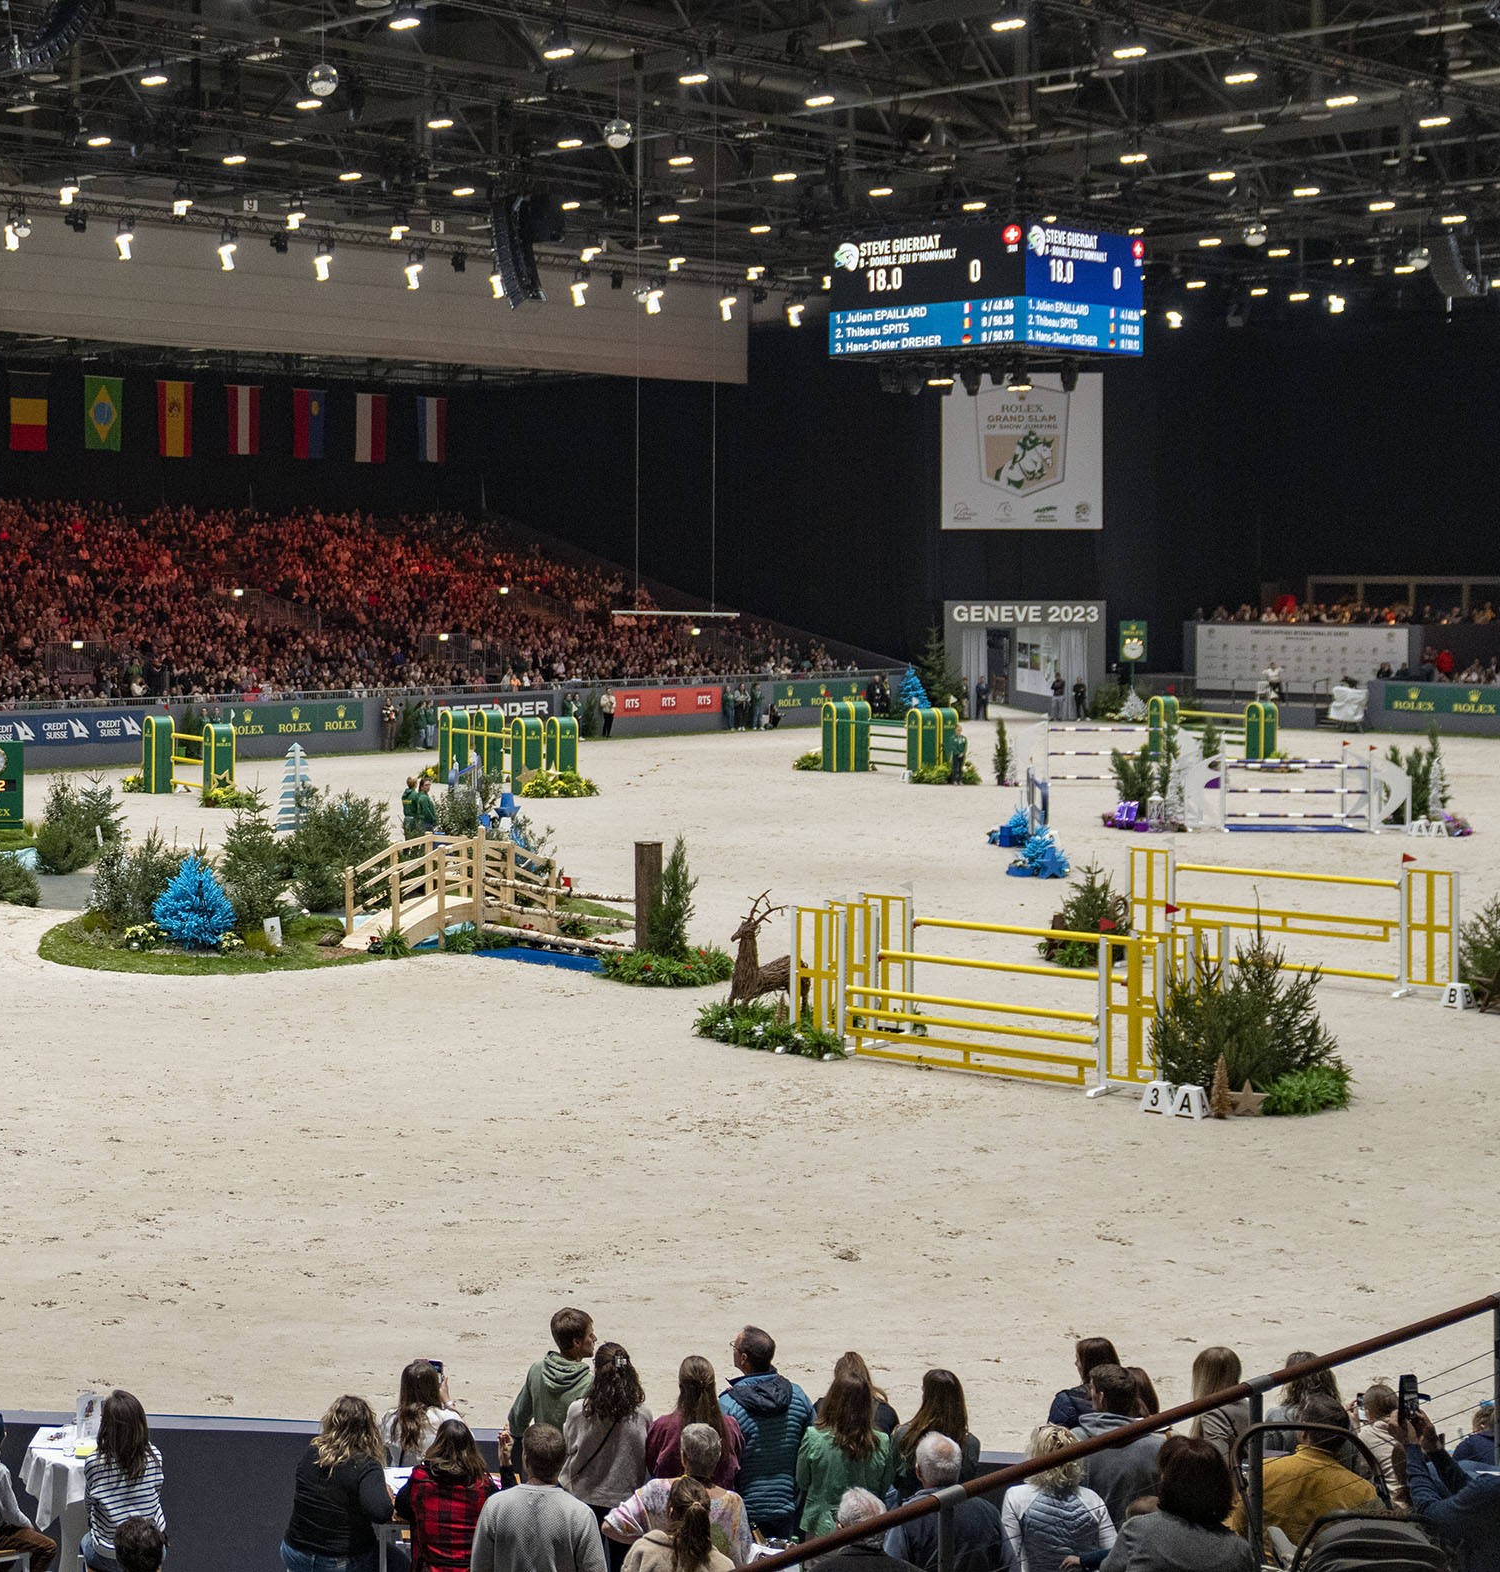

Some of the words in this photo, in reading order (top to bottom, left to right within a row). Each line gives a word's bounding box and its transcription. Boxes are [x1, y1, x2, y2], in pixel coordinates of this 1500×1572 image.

[859, 239, 891, 257] STEVE
[892, 234, 941, 254] GUERDAT
[1045, 228, 1067, 245] STEVE
[1067, 231, 1098, 250] GUERDAT
[869, 254, 897, 268] DOUBLE
[897, 252, 911, 265] JEU
[866, 267, 903, 292] 18.0
[969, 259, 982, 283] 0
[1049, 258, 1074, 284] 18.0
[1112, 267, 1122, 290] 0
[835, 314, 844, 324] 1.
[845, 312, 873, 324] Julien
[874, 306, 927, 321] EPAILLARD
[1028, 298, 1035, 310] 1.
[1054, 301, 1089, 317] EPAILLARD
[1028, 314, 1035, 325] 2.
[1060, 317, 1078, 329] SPITS
[835, 328, 844, 339] 2.
[845, 325, 881, 338] Thibeau
[882, 322, 910, 335] SPITS
[1028, 329, 1035, 340] 3.
[1072, 333, 1098, 346] DREHER
[835, 342, 844, 353] 3.
[846, 339, 900, 352] Hans-Dieter
[901, 335, 942, 348] DREHER
[1001, 404, 1044, 413] ROLEX
[987, 415, 1025, 423] GRAND
[1028, 414, 1057, 422] SLAM
[953, 606, 1042, 623] GENEVE
[1048, 606, 1099, 623] 2023
[625, 698, 640, 709] RTS
[661, 696, 676, 707] RTS
[697, 695, 712, 705] RTS
[778, 697, 801, 707] ROLEX
[1392, 700, 1435, 712] ROLEX
[1452, 702, 1496, 714] ROLEX
[42, 722, 68, 732] CREDIT
[96, 719, 122, 729] CREDIT
[278, 722, 312, 733] ROLEX
[324, 720, 357, 731] ROLEX
[46, 731, 69, 740] SUISSE
[100, 728, 121, 737] SUISSE
[1448, 988, 1457, 1003] B
[1150, 1087, 1159, 1107] 3
[1179, 1092, 1192, 1113] A
